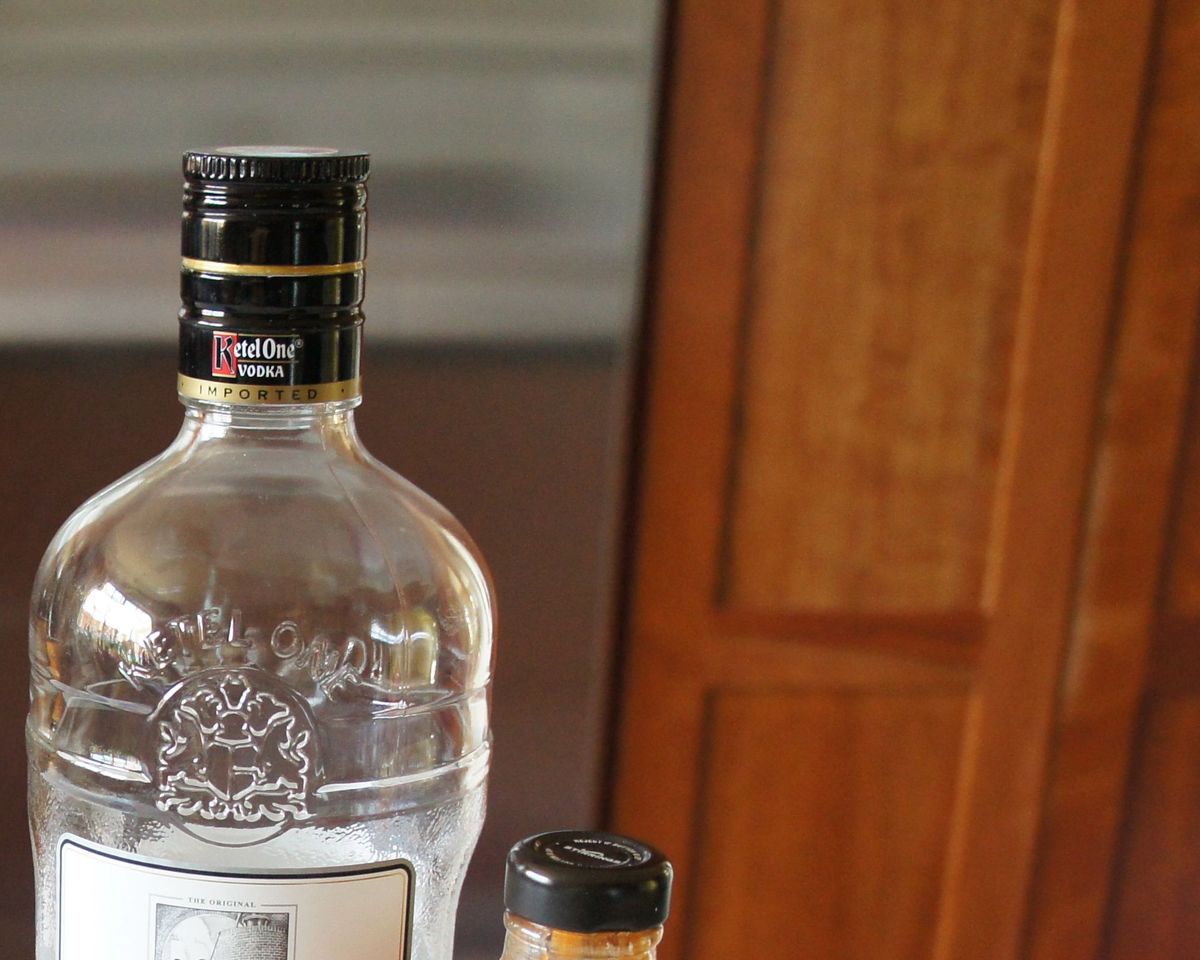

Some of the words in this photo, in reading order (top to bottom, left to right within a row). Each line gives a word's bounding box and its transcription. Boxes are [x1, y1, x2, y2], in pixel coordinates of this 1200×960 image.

[213, 335, 260, 375] Ketel
[263, 338, 296, 360] One
[237, 364, 285, 379] VODKA
[199, 385, 319, 400] IMPORTED
[188, 897, 206, 905] THE
[208, 900, 257, 909] ORIGINAL
